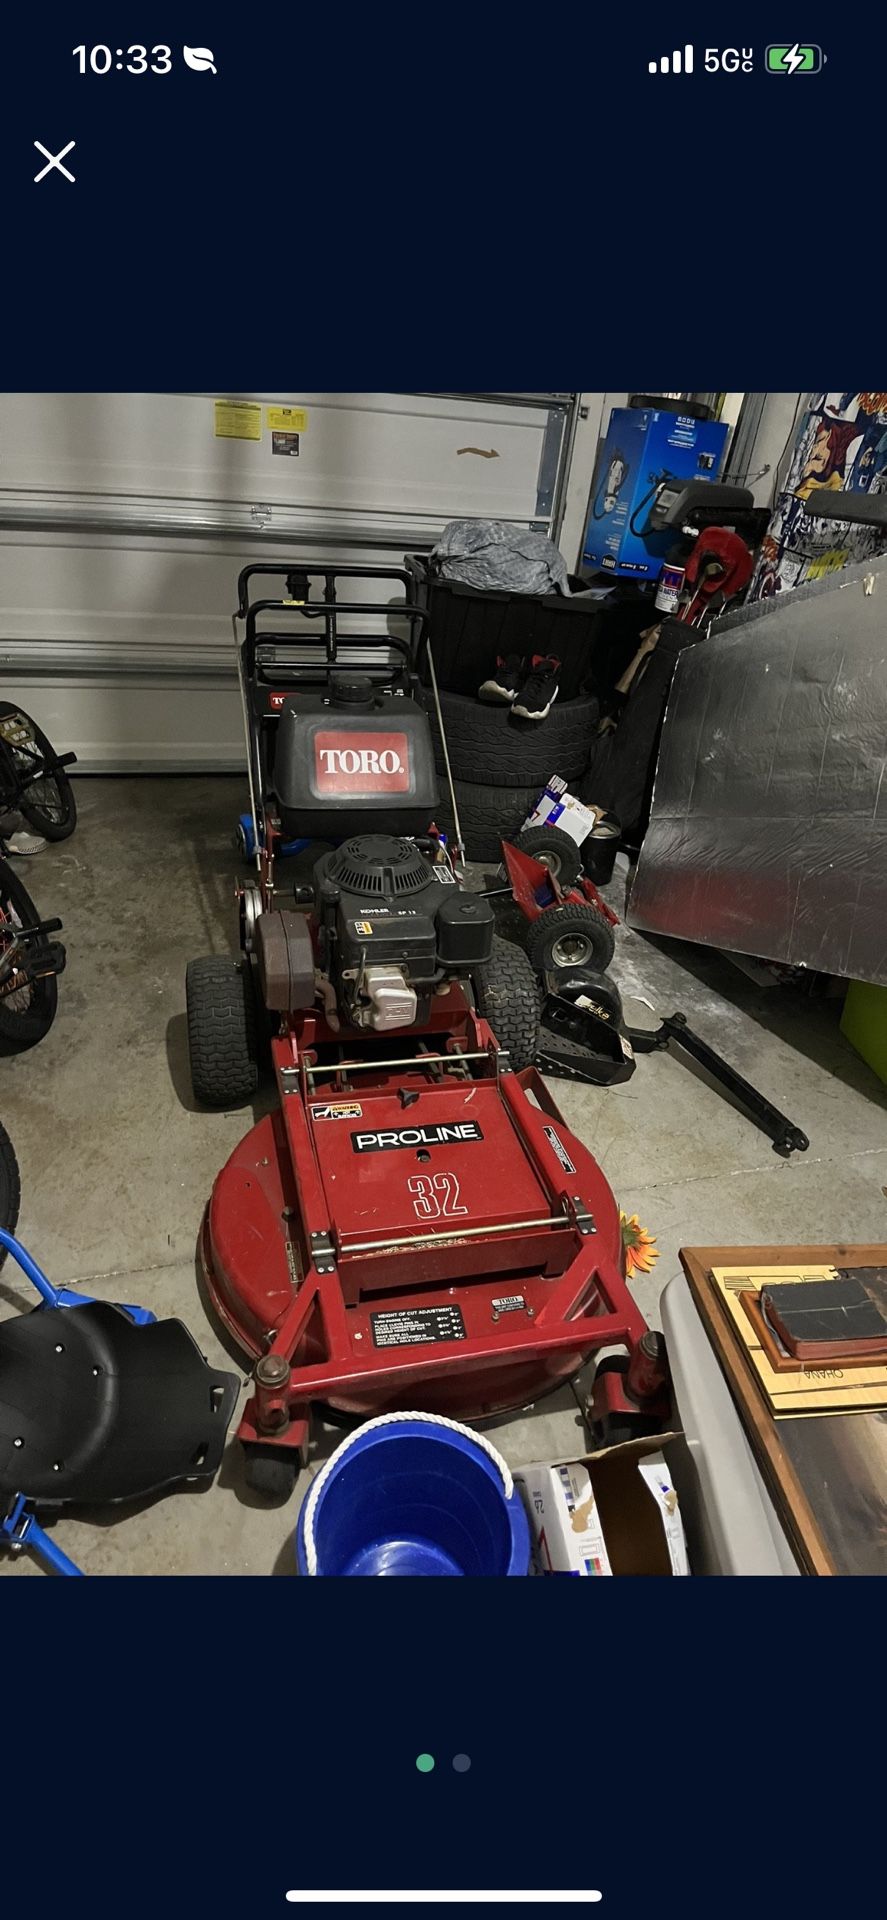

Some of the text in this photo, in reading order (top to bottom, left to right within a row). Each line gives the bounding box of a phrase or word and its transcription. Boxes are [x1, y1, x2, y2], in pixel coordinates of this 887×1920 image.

[72, 44, 173, 74] 10:33
[356, 1124, 478, 1150] PROLINE
[407, 1172, 468, 1219] 32
[377, 1311, 398, 1319] HEIGHT
[418, 1307, 453, 1315] ADJUSTMENT
[804, 1369, 844, 1379] OHANA
